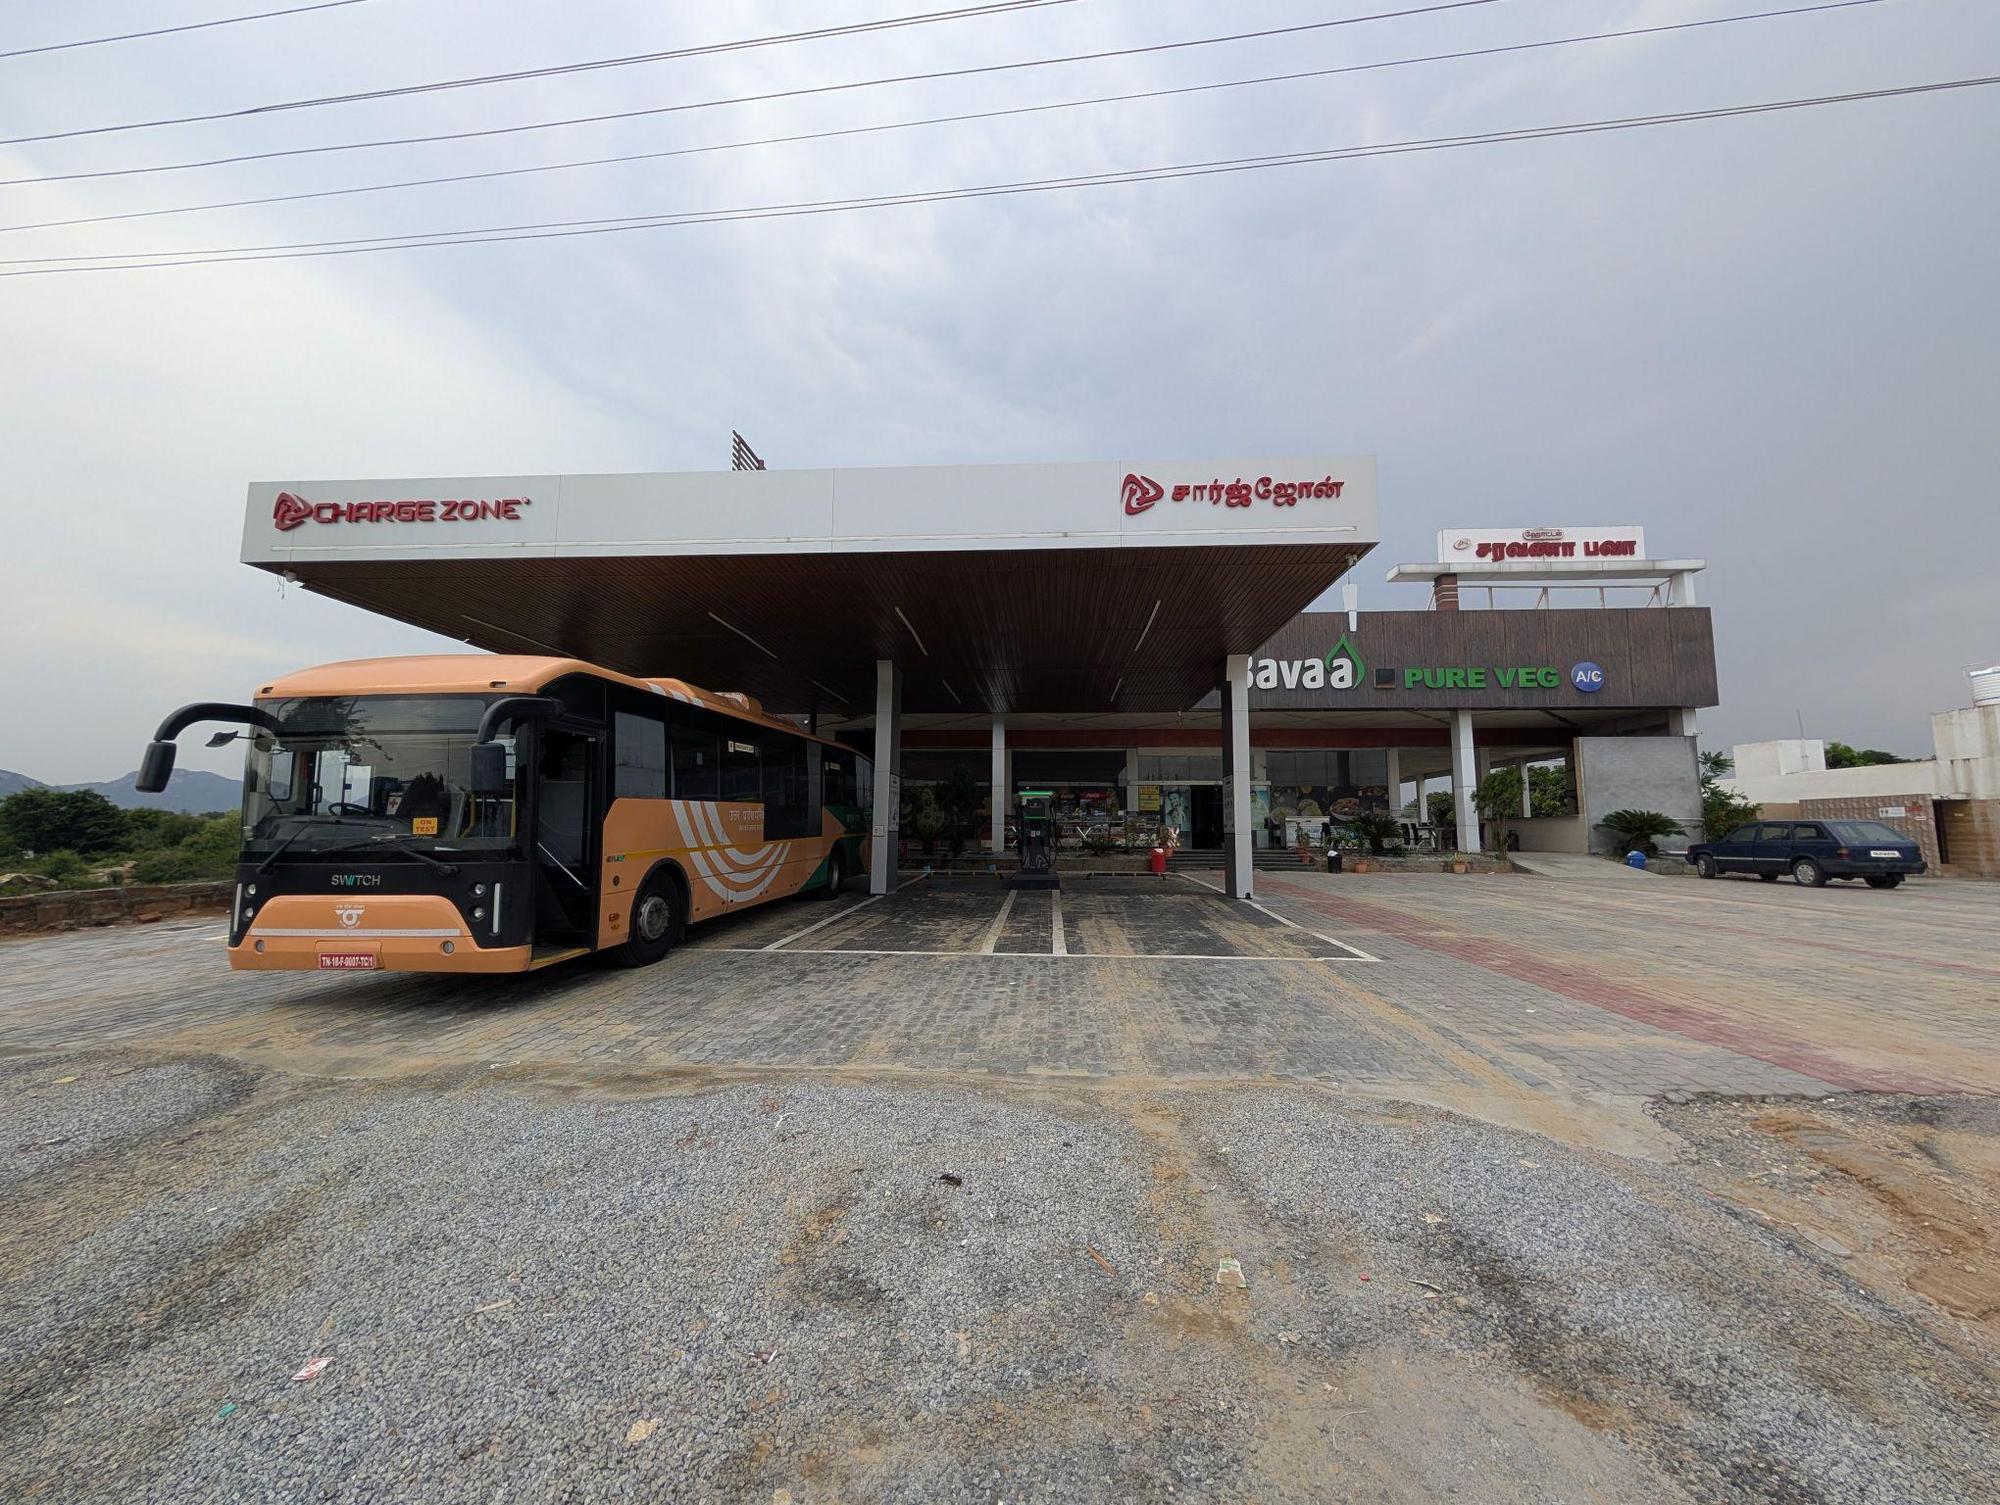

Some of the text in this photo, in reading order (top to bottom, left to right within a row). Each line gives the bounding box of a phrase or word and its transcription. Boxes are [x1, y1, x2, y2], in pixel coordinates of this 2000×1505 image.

[312, 499, 522, 523] CHARGE ZONE
[1404, 666, 1560, 689] PURE VEG
[1575, 670, 1602, 683] A/C
[331, 874, 381, 886] SWITCH
